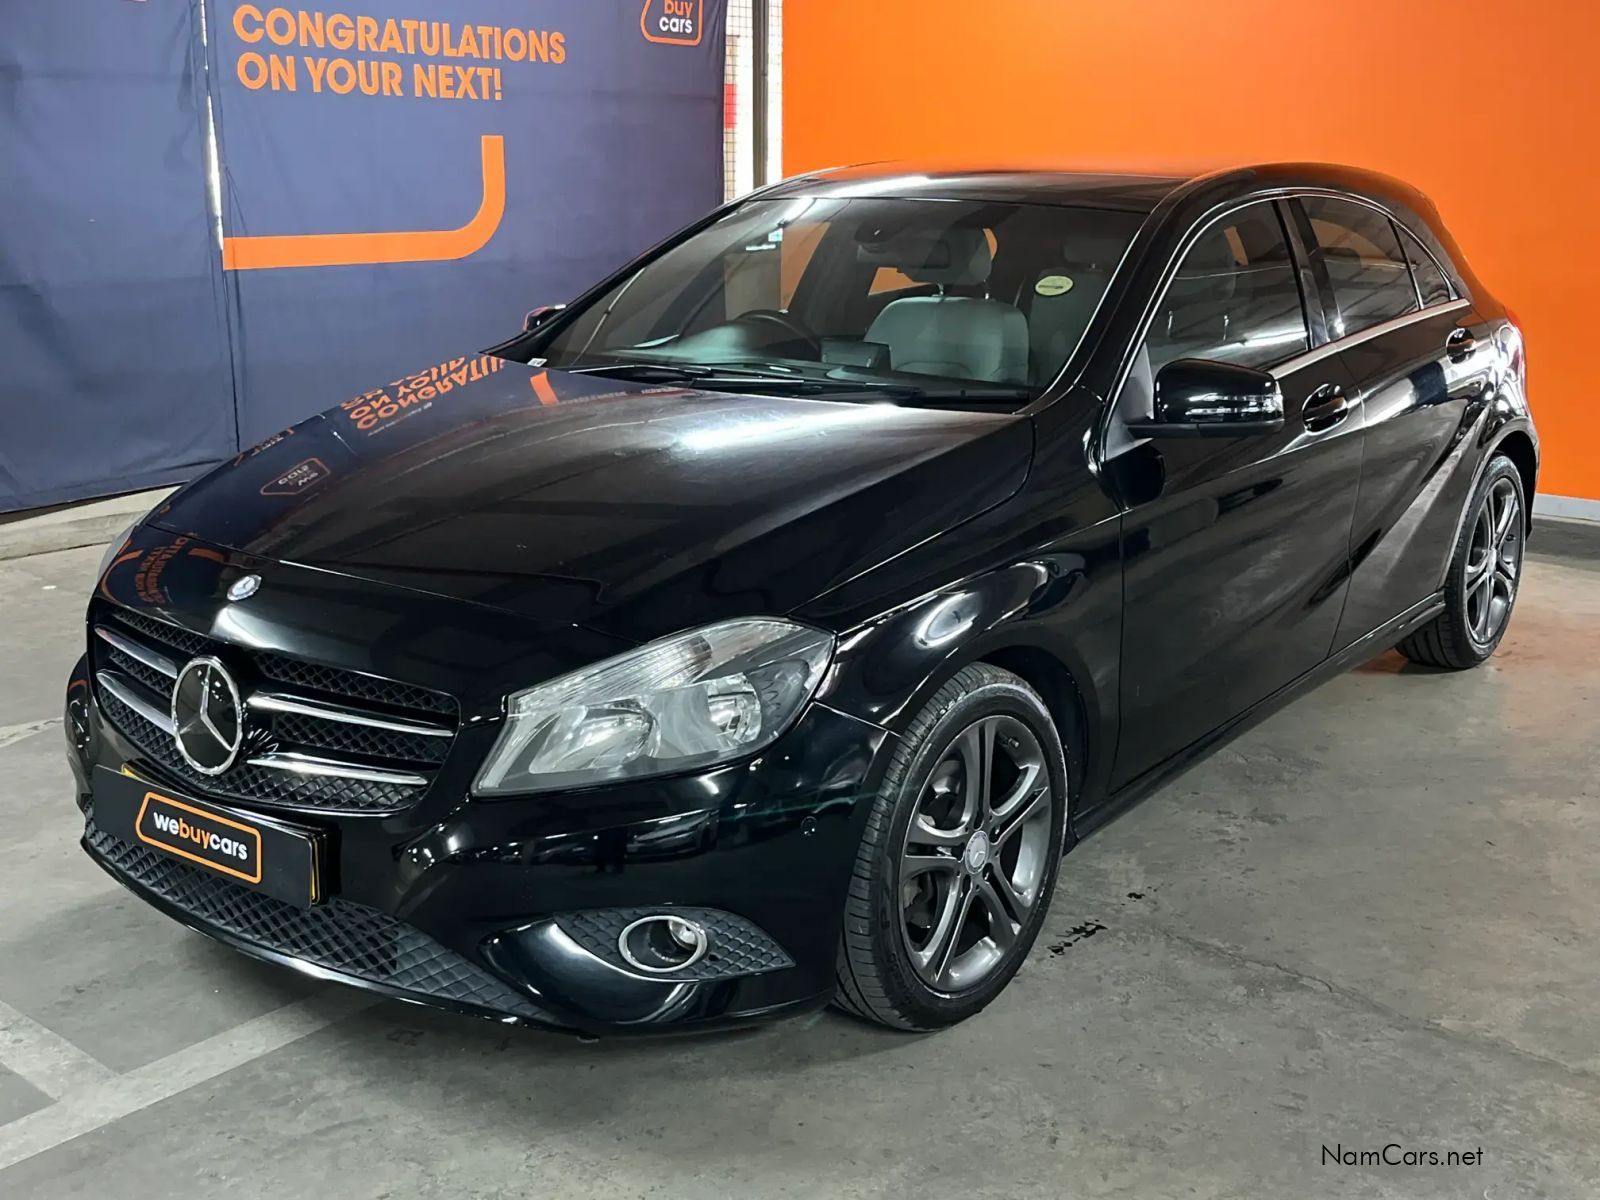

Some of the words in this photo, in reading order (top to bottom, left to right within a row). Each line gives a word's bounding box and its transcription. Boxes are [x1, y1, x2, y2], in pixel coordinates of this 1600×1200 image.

[659, 16, 693, 34] cars
[664, 0, 693, 18] buy
[233, 4, 566, 64] CONGRATULATIONS
[237, 52, 297, 91] ON
[304, 56, 403, 97] YOUR
[413, 63, 502, 101] NEXT!
[153, 811, 249, 861] webuycars
